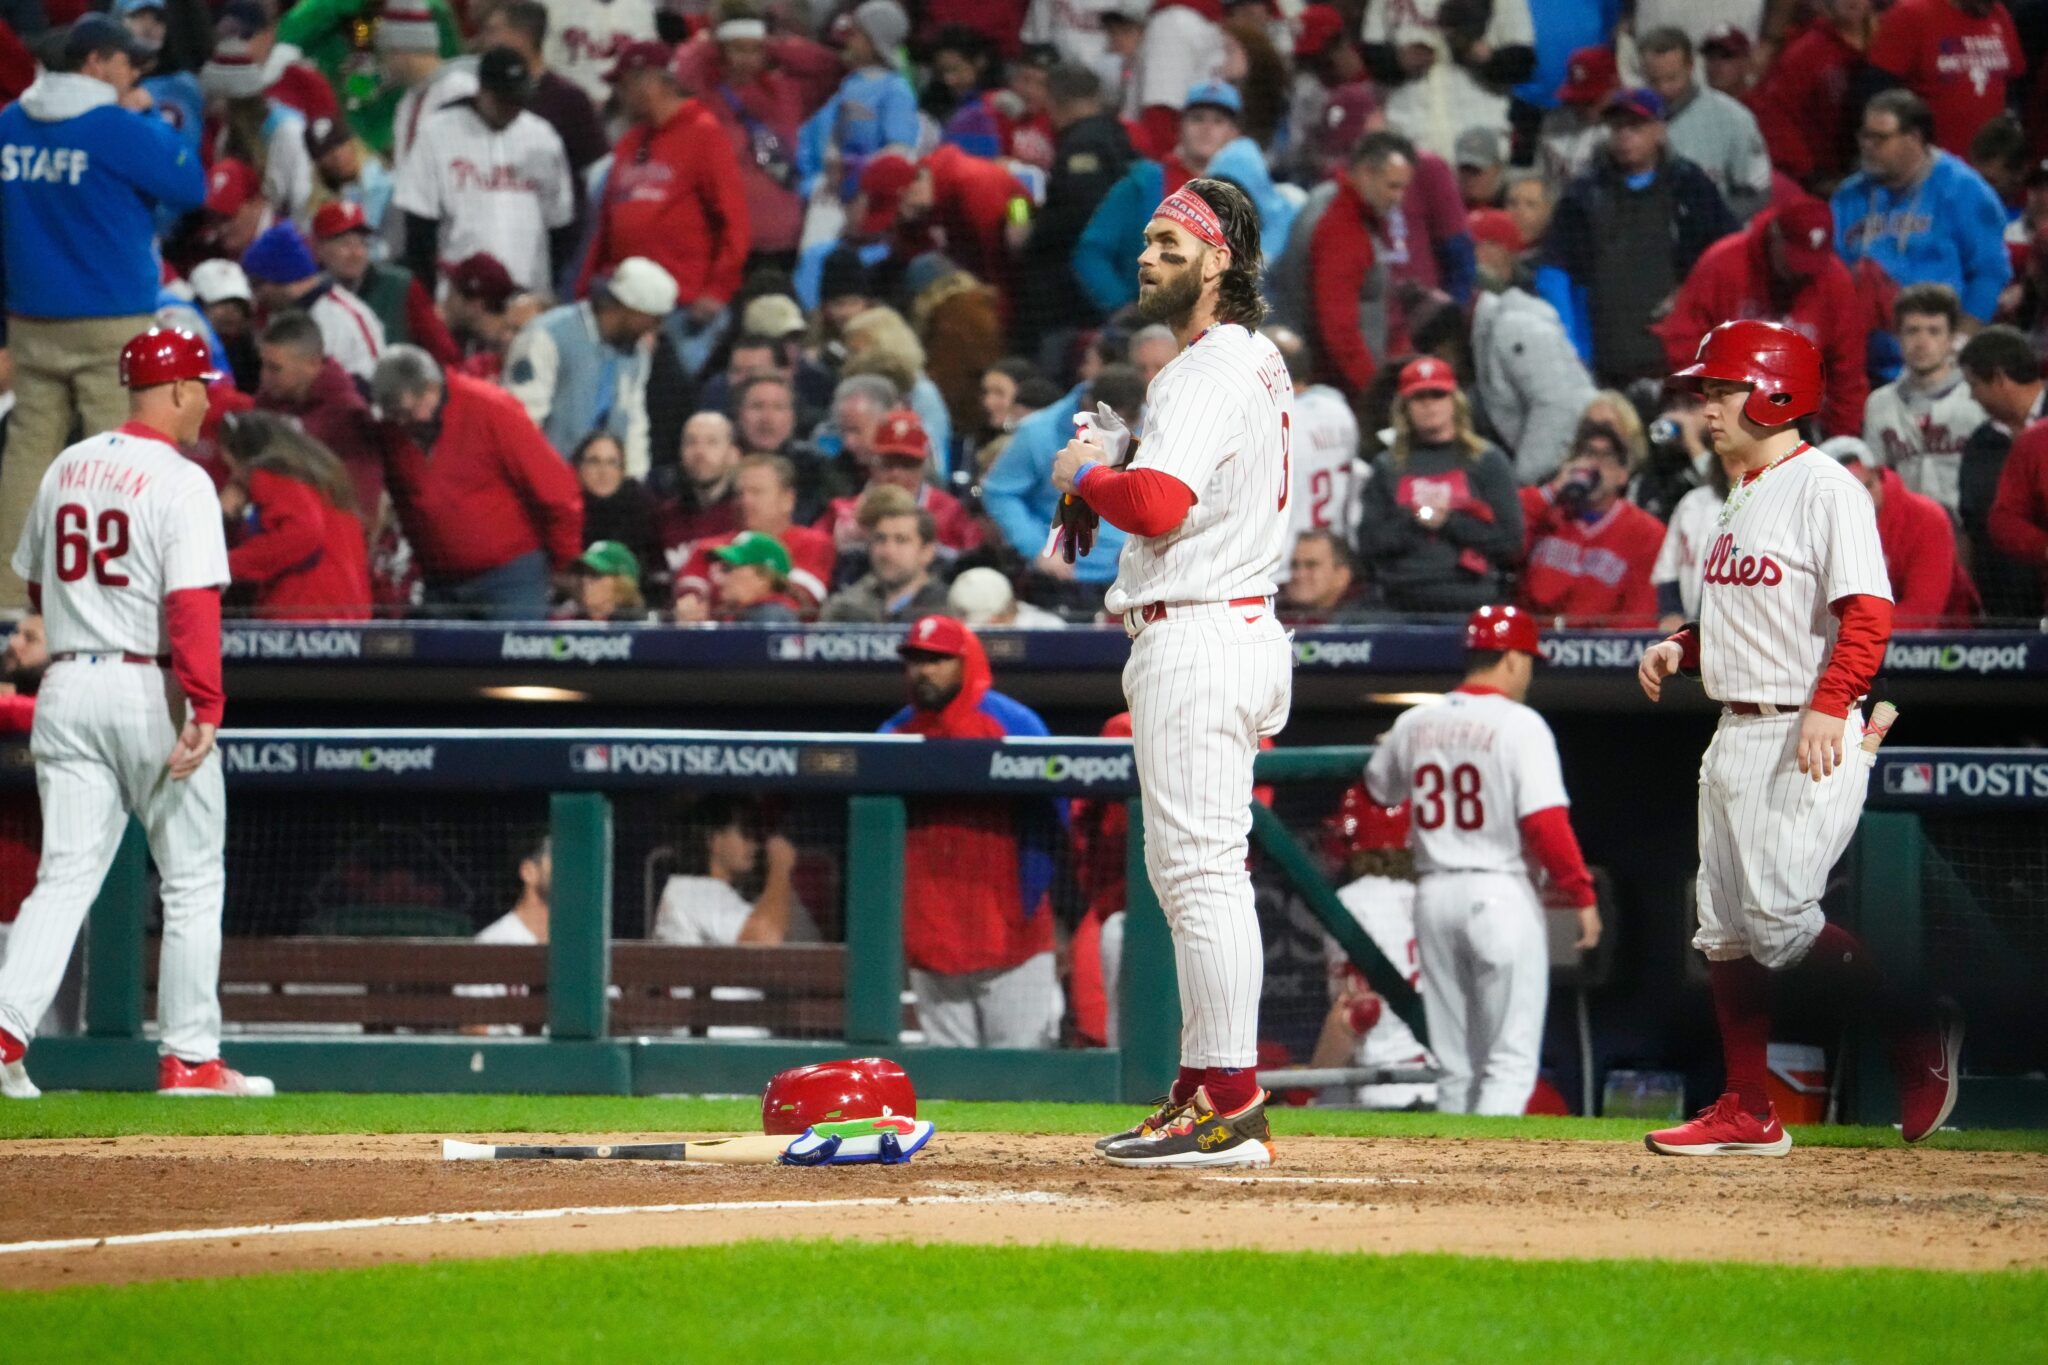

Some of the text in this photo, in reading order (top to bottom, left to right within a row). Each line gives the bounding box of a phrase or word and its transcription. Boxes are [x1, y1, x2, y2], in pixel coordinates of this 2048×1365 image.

[0, 143, 88, 186] STAFF
[1170, 198, 1215, 237] HARPER
[58, 459, 152, 498] WATHAN
[56, 503, 130, 587] 62
[221, 629, 362, 659] OSTSEASON
[501, 631, 633, 665] loanDepot
[1884, 641, 2028, 674] loanDepot
[226, 743, 434, 774] NLCS loanDepot
[610, 744, 798, 777] POSTSEASON
[989, 751, 1131, 786] loanDepot
[1413, 762, 1484, 831] 38
